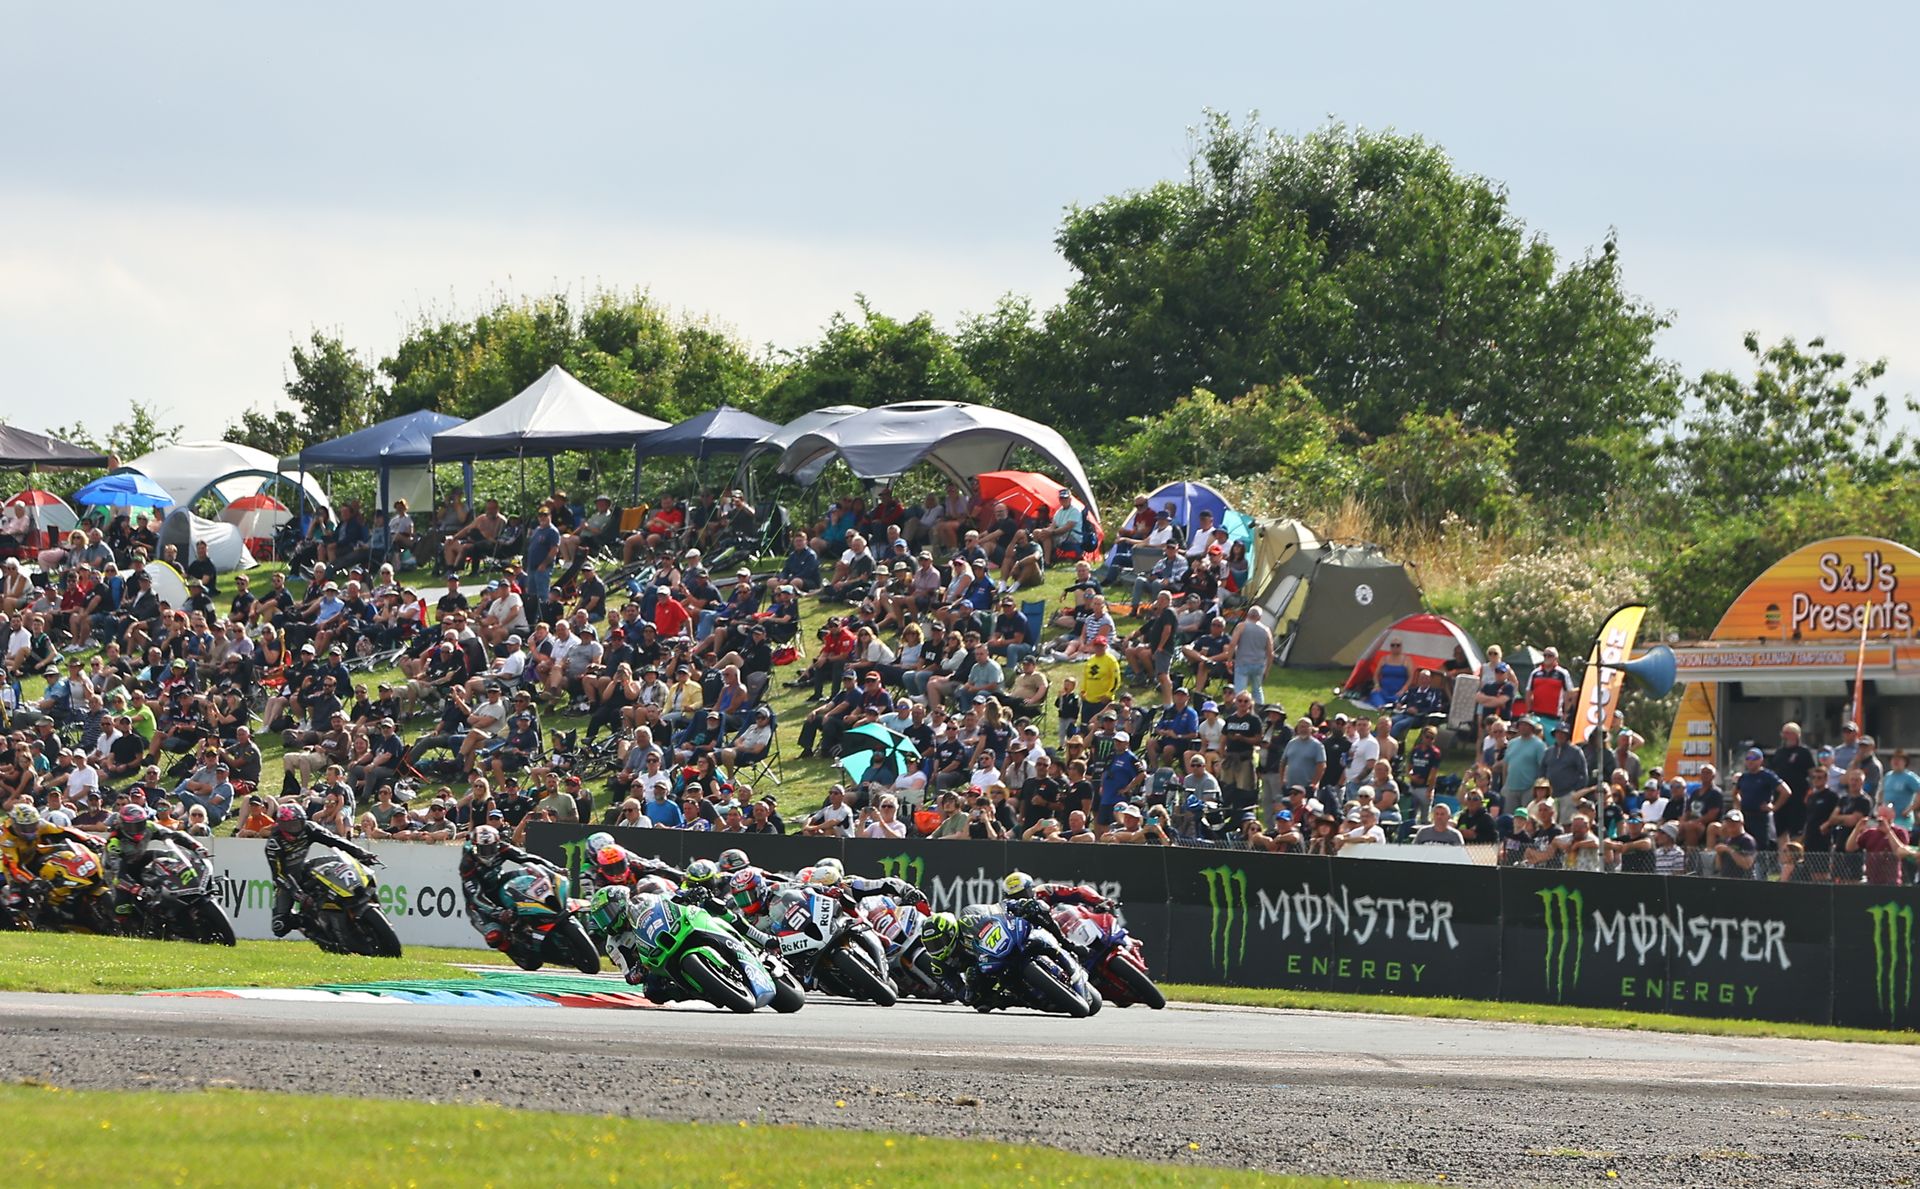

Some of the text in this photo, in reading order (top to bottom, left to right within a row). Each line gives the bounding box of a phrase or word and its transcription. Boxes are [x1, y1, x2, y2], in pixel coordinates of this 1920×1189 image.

[1819, 550, 1896, 592] S&J's
[1791, 591, 1911, 632] Presents
[788, 907, 811, 930] 91
[1256, 882, 1459, 949] MONSTER
[985, 926, 1001, 949] 77
[1592, 902, 1791, 970] MONSTER
[1287, 955, 1426, 982] ENERGY
[1621, 977, 1759, 1004] ENERGY
